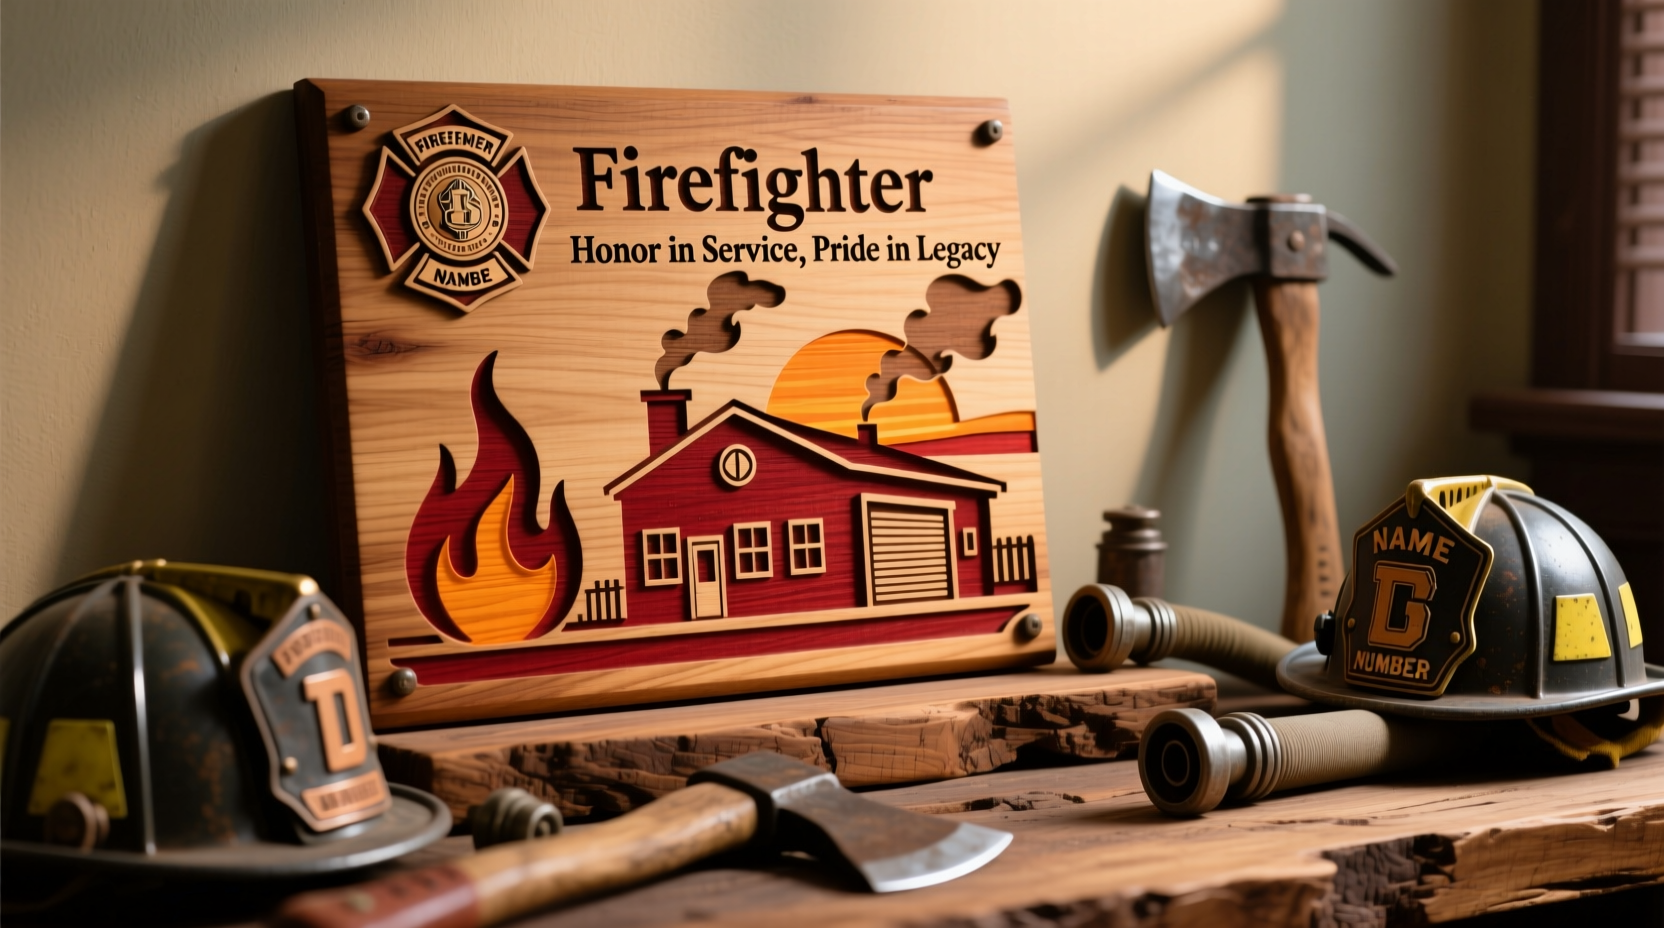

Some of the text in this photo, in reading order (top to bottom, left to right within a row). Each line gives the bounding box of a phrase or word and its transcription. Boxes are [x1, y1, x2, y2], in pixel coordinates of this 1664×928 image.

[572, 145, 933, 232] Firefighter
[570, 234, 1001, 269] Honor in Service, Pride in Legacy
[1373, 526, 1455, 564] NAME
[1353, 650, 1430, 680] NUMBER
